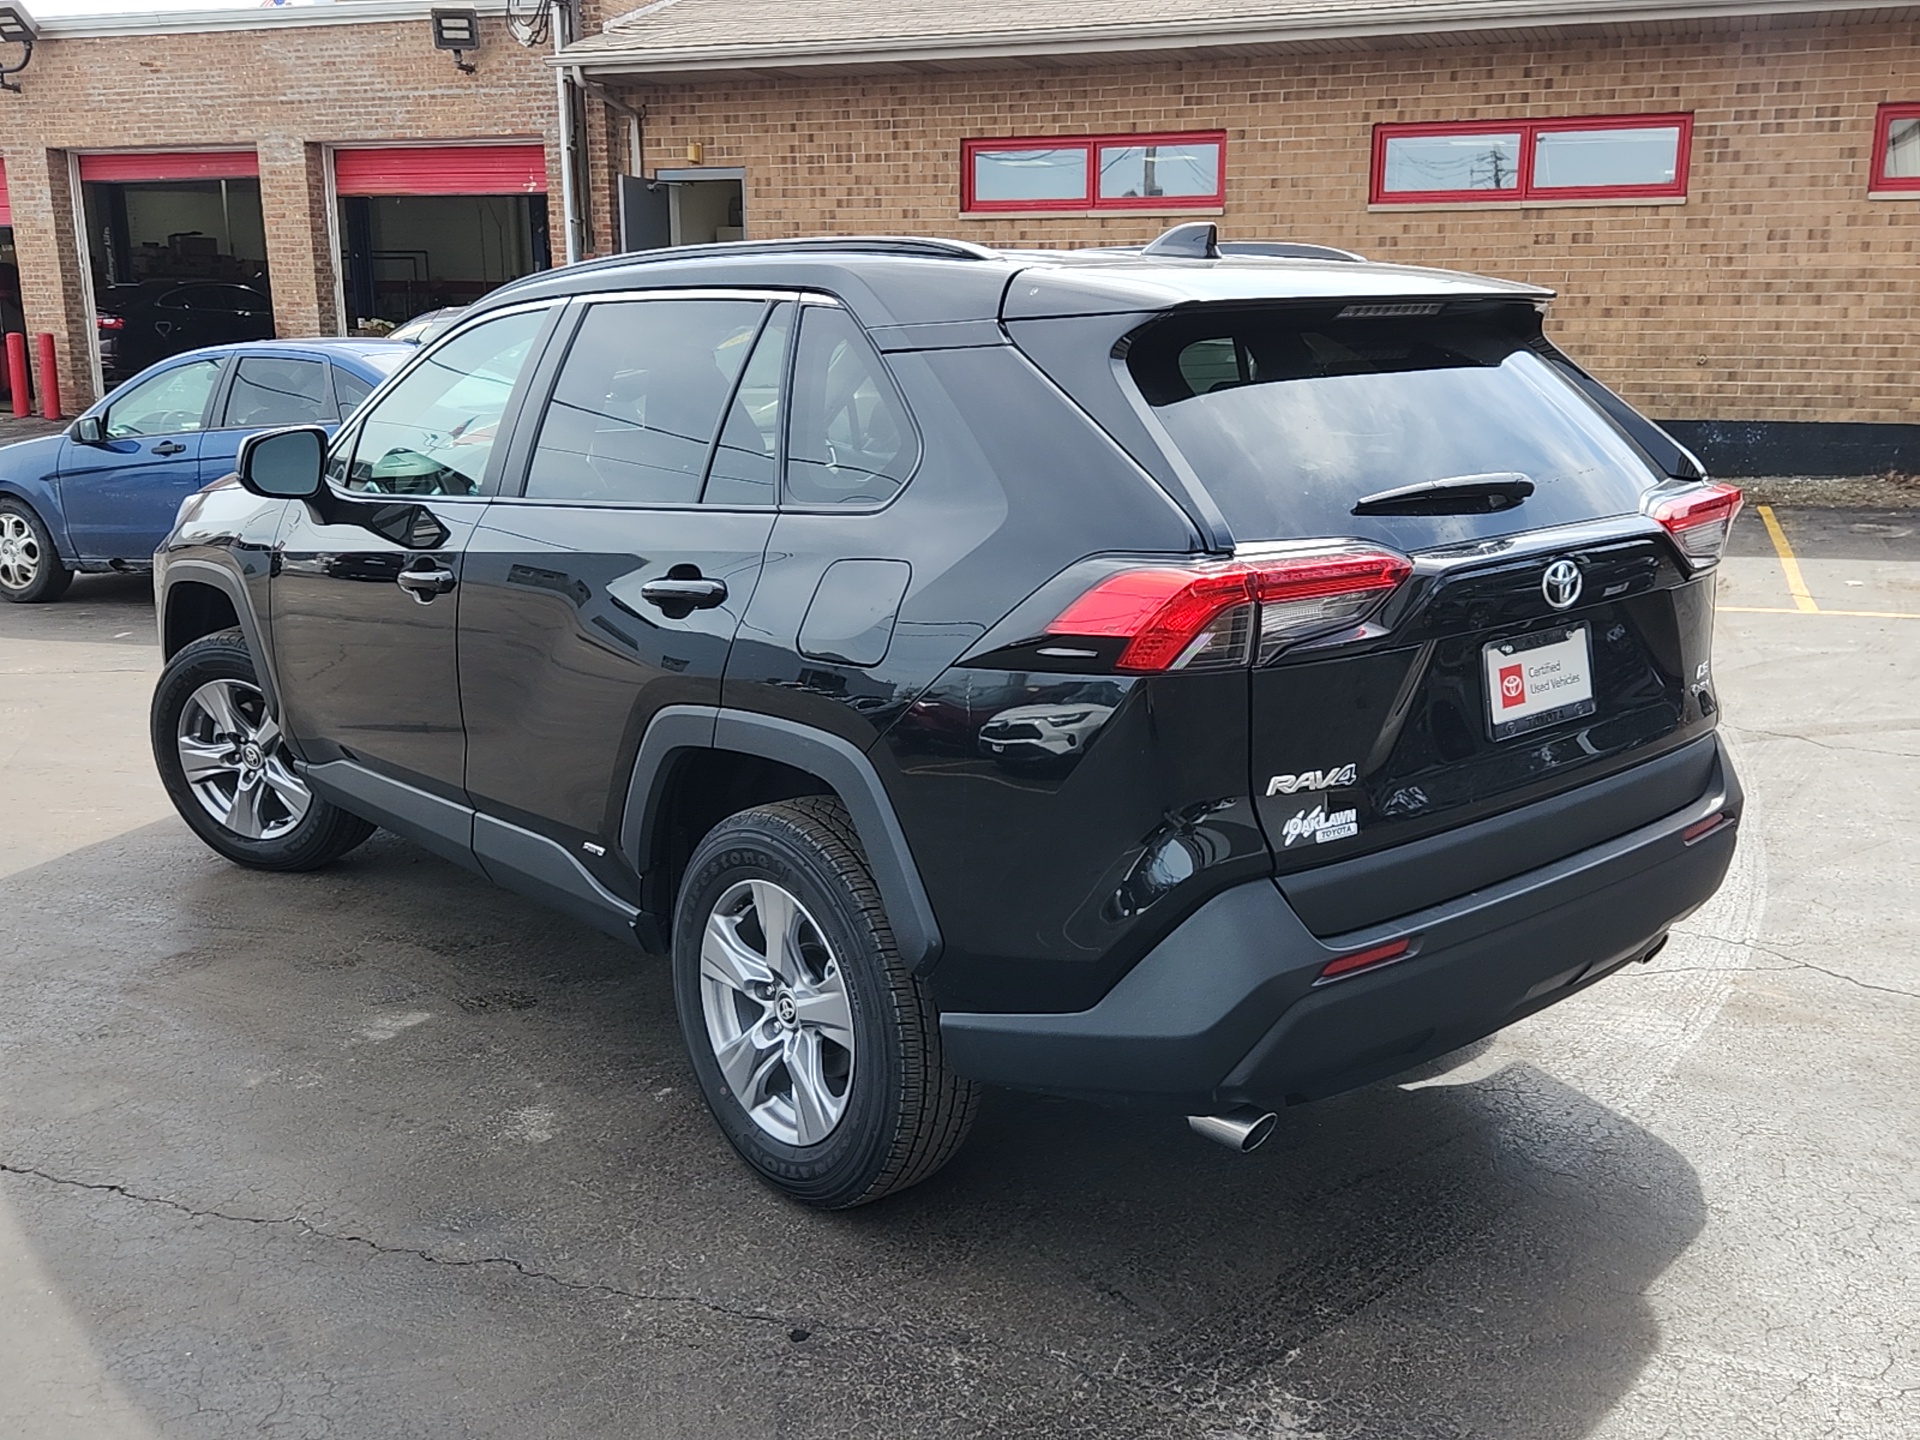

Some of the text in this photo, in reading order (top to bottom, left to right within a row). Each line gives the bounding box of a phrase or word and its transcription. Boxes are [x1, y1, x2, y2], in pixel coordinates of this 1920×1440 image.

[1528, 660, 1561, 678] Certified
[1530, 673, 1581, 695] Used Vehicles
[1528, 710, 1565, 726] TOYOTA
[1265, 762, 1357, 797] RAV4
[1321, 825, 1352, 838] TOYOTA
